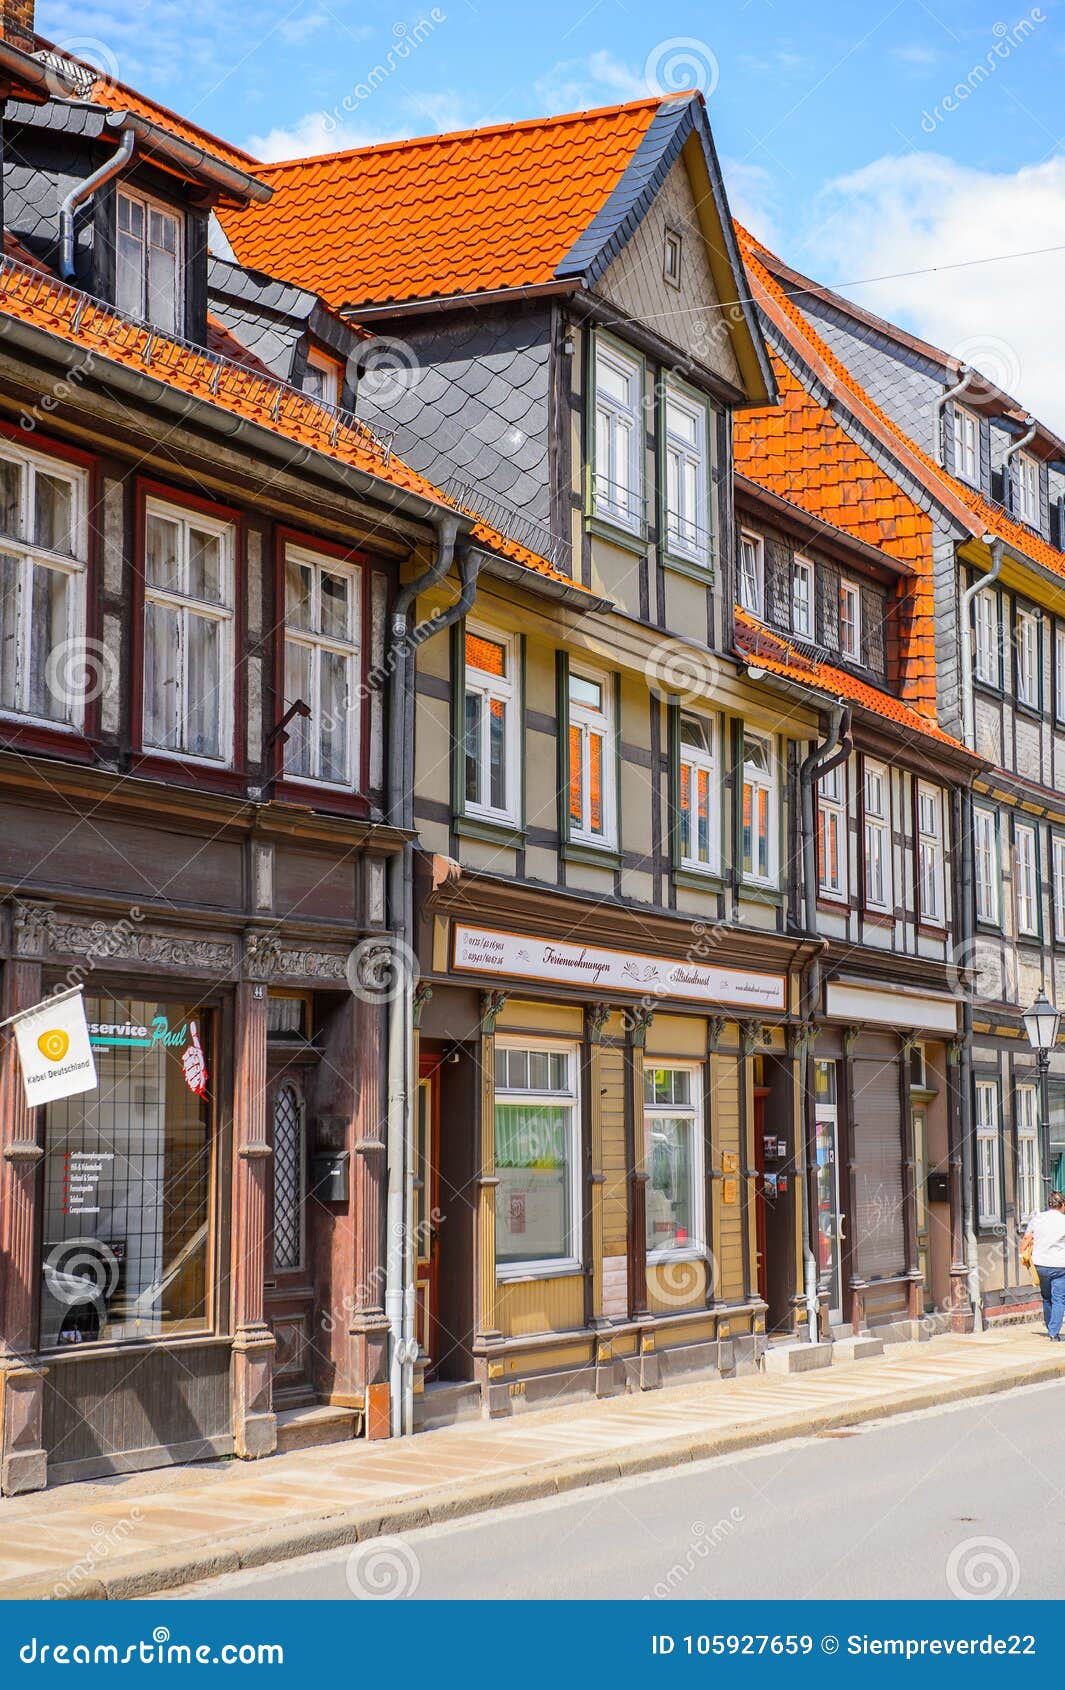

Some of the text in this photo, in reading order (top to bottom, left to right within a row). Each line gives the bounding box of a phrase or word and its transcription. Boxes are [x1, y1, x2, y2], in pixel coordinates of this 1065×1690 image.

[543, 946, 611, 984] Ferienwohnungen
[151, 1016, 187, 1048] Paul
[27, 1059, 90, 1085] Kabel Deutschland
